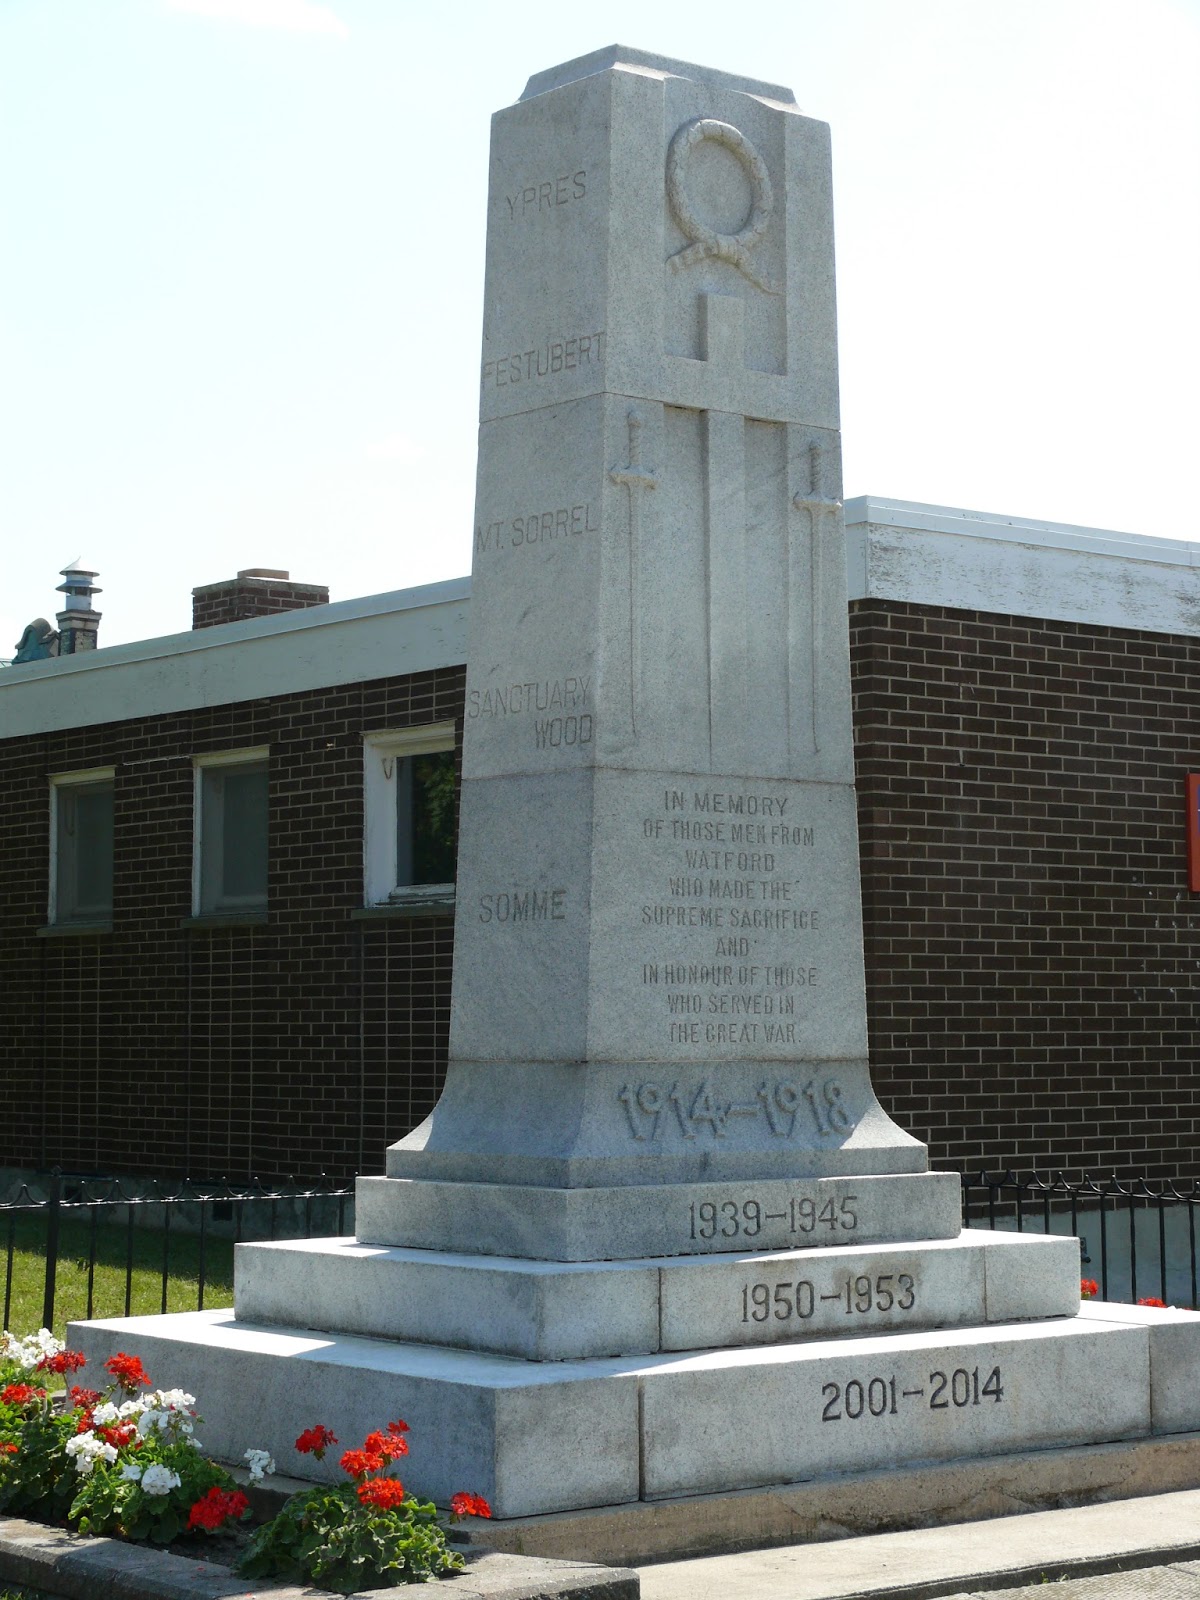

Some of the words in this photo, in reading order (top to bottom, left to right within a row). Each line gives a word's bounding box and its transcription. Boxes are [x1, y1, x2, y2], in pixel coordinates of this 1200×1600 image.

[506, 170, 586, 221] YPRES
[482, 331, 605, 387] FESTUBERT
[511, 504, 596, 546] SORREL
[468, 676, 591, 719] SANCTUARY
[534, 714, 593, 749] WOOD
[664, 791, 684, 811] IN
[694, 793, 788, 817] MEMORY
[643, 819, 664, 838] OF
[672, 820, 725, 842] THOSE
[731, 824, 766, 844] MEN
[772, 827, 815, 847] FROM
[685, 850, 775, 872] WATFORD
[669, 878, 702, 898] WHO
[709, 879, 753, 899] MADE
[762, 881, 792, 900] THE
[479, 890, 567, 923] SOMME
[641, 905, 723, 927] SUPREME
[730, 907, 819, 930] SACRIFICE
[715, 937, 750, 957] AND
[643, 964, 658, 984] IN
[665, 965, 732, 987] HONOUR
[738, 967, 758, 985] OF
[765, 967, 818, 987] THOSE
[667, 994, 702, 1014] WHO
[708, 995, 773, 1014] SERVED
[779, 996, 794, 1015] IN
[669, 1023, 699, 1043] THE
[705, 1023, 758, 1043] GREAT
